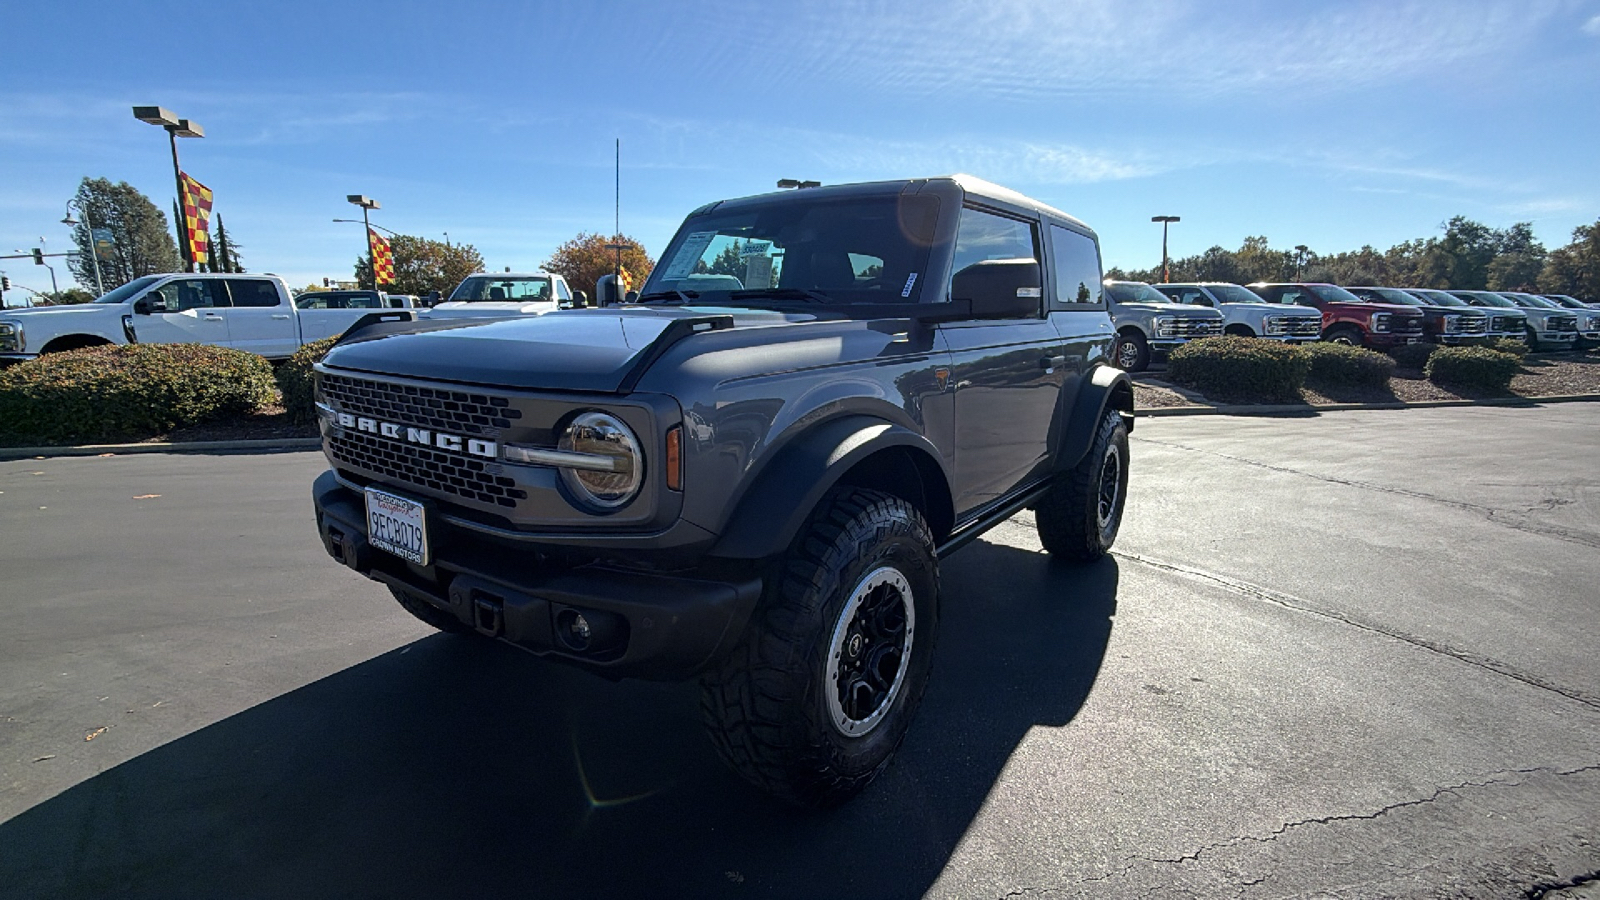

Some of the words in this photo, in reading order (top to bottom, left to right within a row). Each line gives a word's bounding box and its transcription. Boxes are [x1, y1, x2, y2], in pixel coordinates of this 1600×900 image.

[338, 412, 498, 458] BRONCO
[377, 493, 408, 509] REDDING
[372, 511, 423, 552] 9FCB079
[371, 538, 394, 553] CROWN
[394, 545, 421, 563] MOTORS
